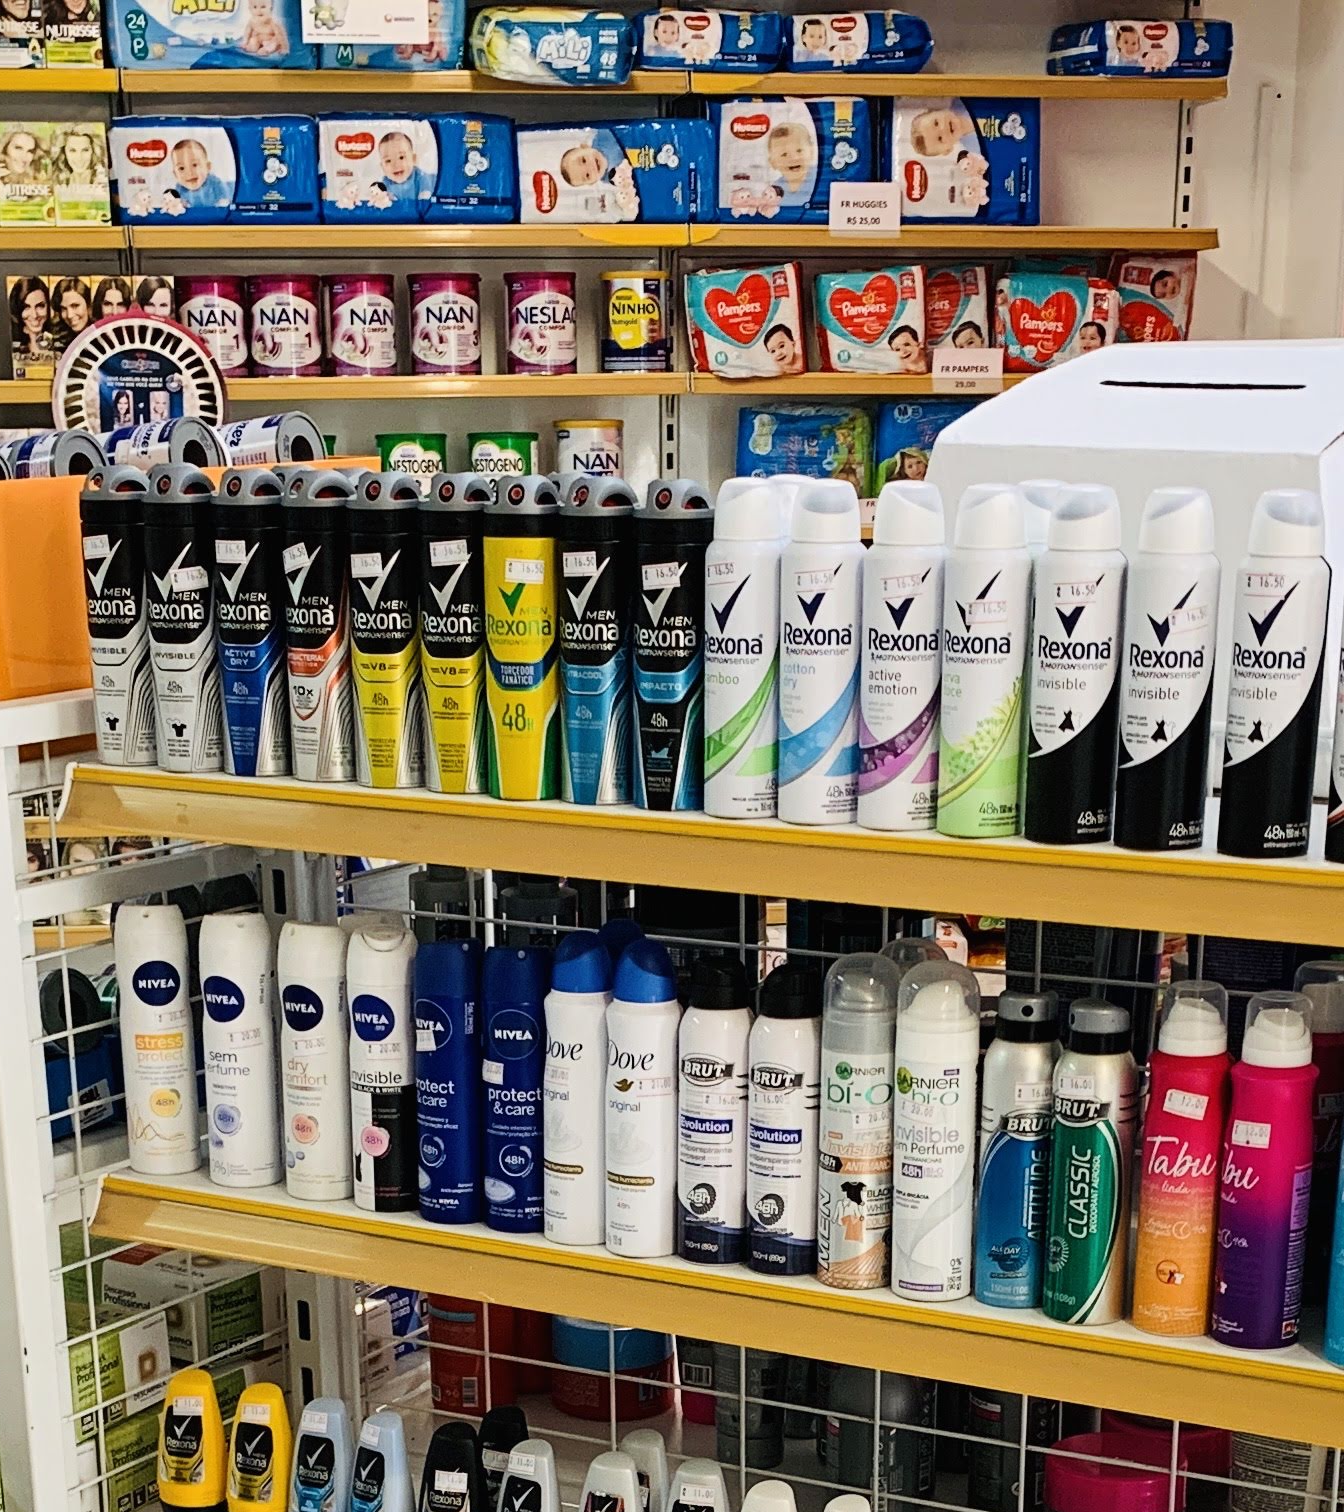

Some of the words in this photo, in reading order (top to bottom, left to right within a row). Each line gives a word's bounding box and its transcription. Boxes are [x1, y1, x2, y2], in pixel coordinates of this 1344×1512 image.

[126, 13, 146, 29] 24
[133, 38, 144, 53] P
[338, 49, 353, 61] M
[840, 200, 851, 209] FR
[854, 200, 888, 209] HUGGIES
[859, 217, 880, 226] 25,00
[426, 306, 474, 324] NAN
[716, 300, 762, 318] Pampers
[842, 301, 887, 319] Pampers
[187, 308, 237, 328] NAN
[259, 308, 309, 326] NAN
[350, 308, 394, 325] NAN
[1019, 312, 1064, 335] Pampers
[940, 365, 949, 373] FR
[951, 365, 989, 374] PAMPERS
[573, 453, 619, 469] NAN
[104, 588, 131, 597] MEN
[172, 592, 200, 601] MEN
[239, 592, 267, 601] MEN
[380, 600, 408, 610] MEN
[451, 604, 479, 613] MEN
[586, 610, 616, 620] MEN
[663, 617, 693, 626] MEN
[487, 617, 552, 637] Rexona
[784, 622, 852, 648] Rexona
[868, 628, 939, 653] Rexona
[944, 630, 1011, 655] Rexona
[1038, 635, 1112, 660] Rexona
[224, 650, 256, 658] ACTIVE
[1129, 643, 1204, 670] Rexona
[1232, 643, 1306, 670] Rexona
[230, 657, 249, 666] DRY
[371, 662, 386, 671] V8
[868, 671, 902, 682] active
[868, 683, 917, 698] emotion
[1037, 677, 1087, 691] invisible
[1128, 686, 1180, 701] invisible
[138, 978, 175, 989] NIVEA
[206, 992, 239, 1006] NIVEA
[285, 1002, 316, 1015] NIVEA
[355, 1013, 389, 1026] NIVEA
[136, 1035, 183, 1048] stress
[493, 1028, 533, 1041] NIVEA
[209, 1051, 238, 1063] sem
[488, 1087, 542, 1105] protect
[506, 1103, 535, 1116] care
[910, 1143, 965, 1155] Perfume
[1146, 1135, 1217, 1178] Tabu
[1067, 1144, 1094, 1240] CLASSIC
